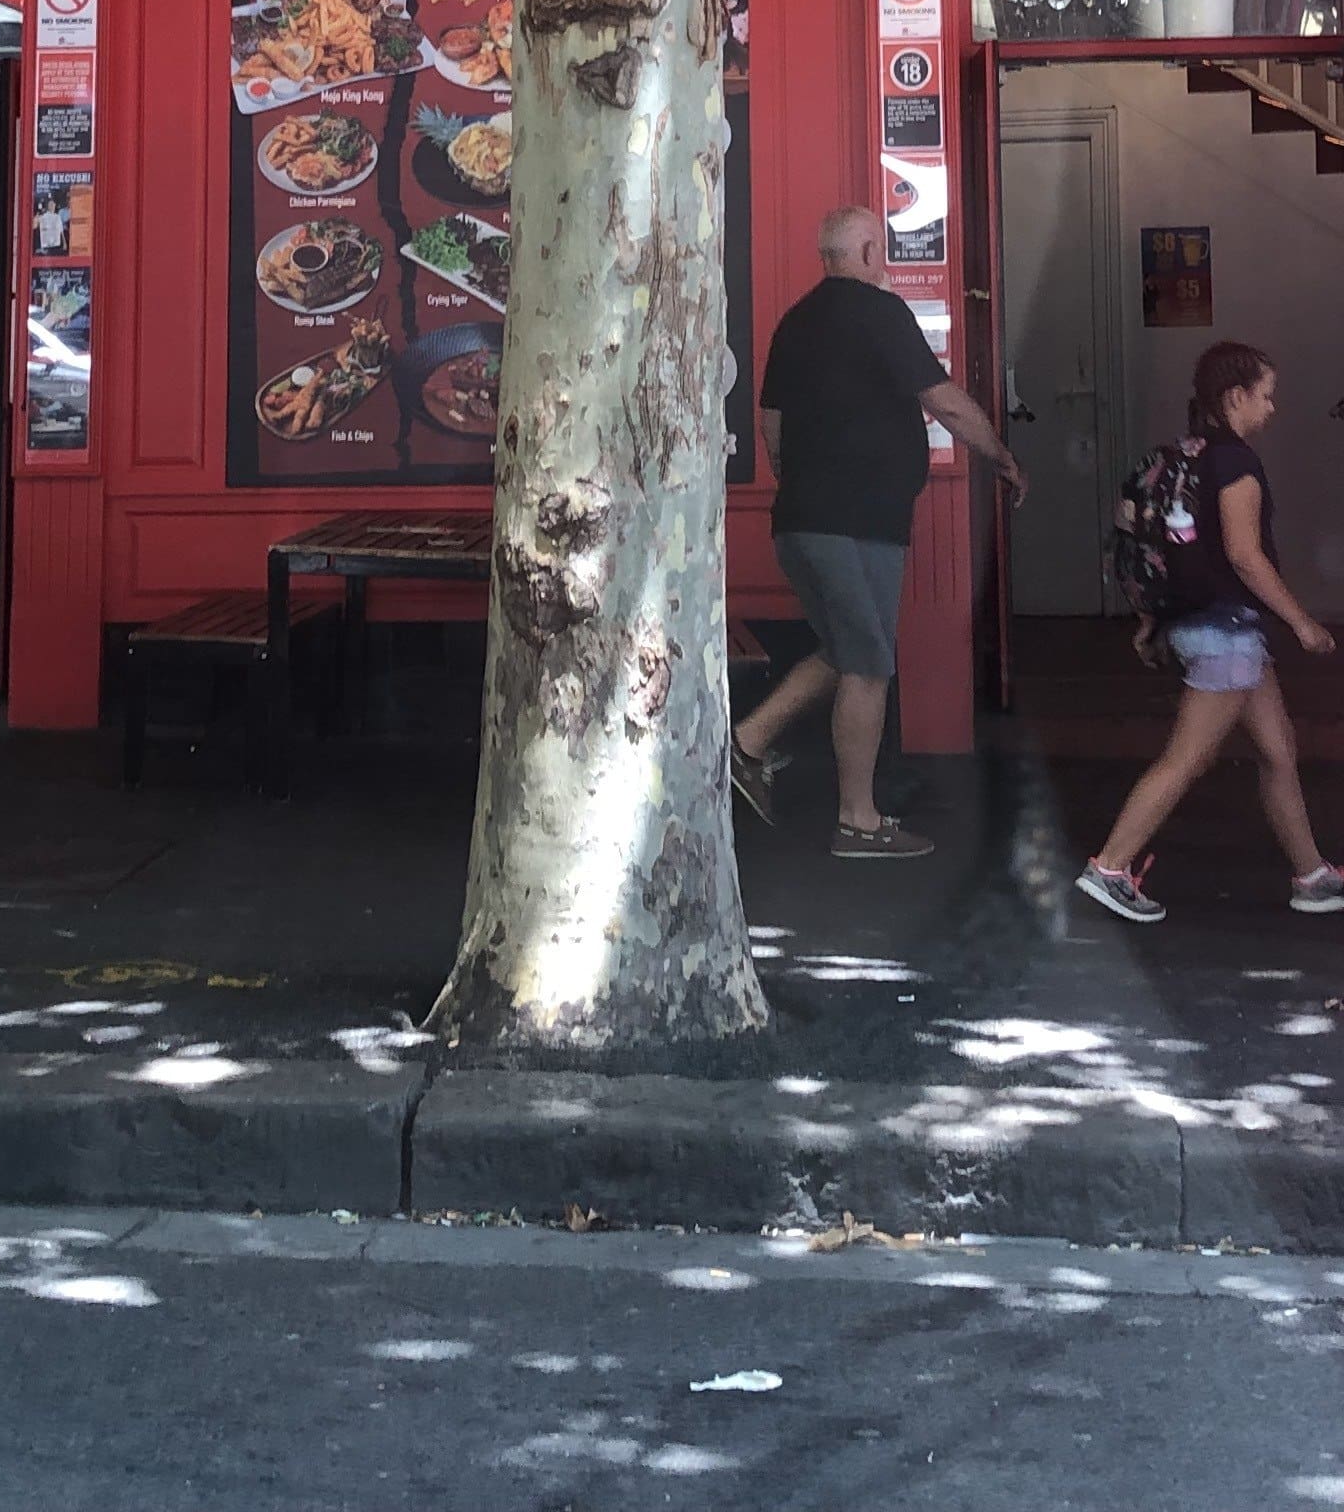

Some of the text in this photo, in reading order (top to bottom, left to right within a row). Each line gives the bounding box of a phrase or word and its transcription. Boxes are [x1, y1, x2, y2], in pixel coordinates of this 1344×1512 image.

[900, 63, 921, 83] 18
[320, 90, 384, 104] Mojo King Kong
[36, 173, 50, 183] NO
[289, 197, 316, 208] Chicken
[427, 293, 469, 307] Crying Tiger
[294, 315, 335, 328] Rump Steak
[331, 430, 346, 441] Fish
[355, 430, 374, 442] Chips
